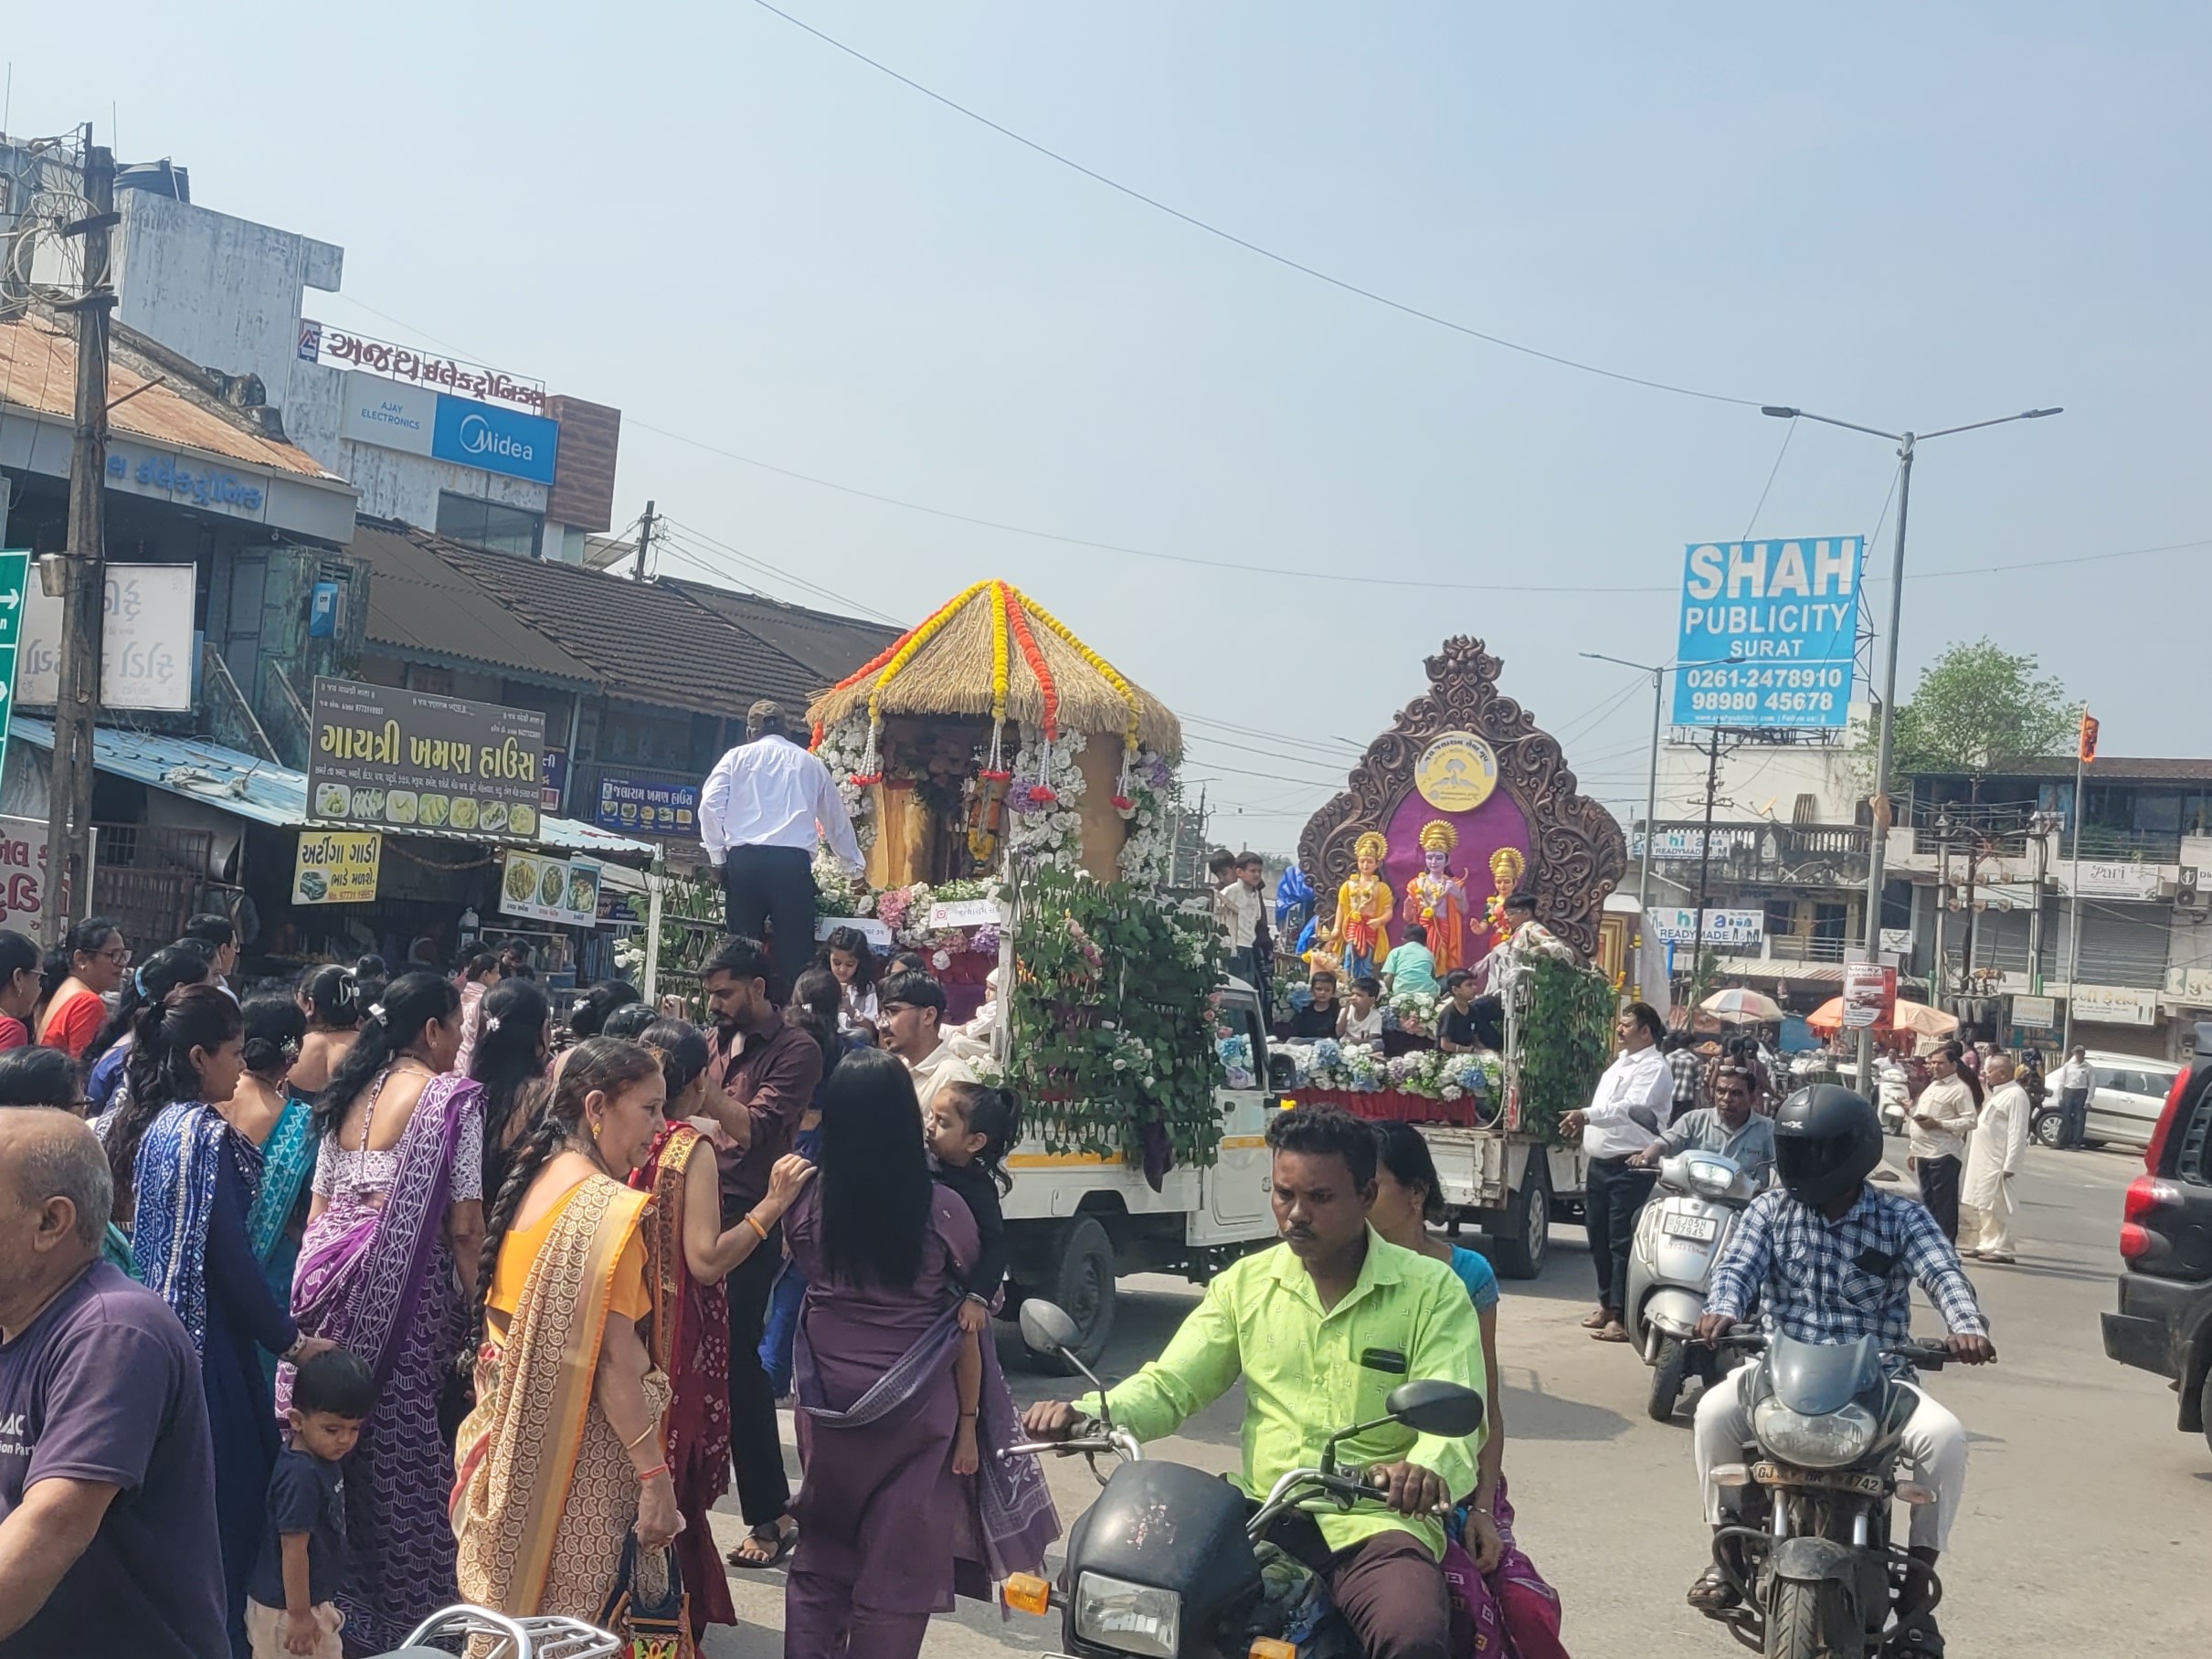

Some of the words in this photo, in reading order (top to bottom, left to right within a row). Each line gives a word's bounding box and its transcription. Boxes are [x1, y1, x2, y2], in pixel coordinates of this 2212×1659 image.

[327, 333, 419, 381] અજય
[381, 401, 403, 413] AJAY
[361, 408, 419, 430] ELECTRONICS
[464, 420, 533, 461] Midea
[1688, 539, 1856, 600] SHAH
[1686, 603, 1849, 634] PUBLICITY
[1730, 639, 1804, 657] SURAT
[1688, 668, 1842, 688] 0261-2478910
[1692, 692, 1757, 711] 98980
[1764, 691, 1833, 711] 45678
[321, 719, 400, 766] ગાયત્રી
[410, 735, 472, 775] ખમણ
[479, 736, 535, 781] હાઉસ
[613, 786, 644, 800] જલારામ
[647, 790, 669, 804] ખમણ
[672, 789, 693, 806] હાઉસ
[349, 837, 377, 863] ગાડી
[331, 868, 348, 886] ભાડે
[0, 1411, 26, 1436] AC
[1758, 1466, 1774, 1479] GJ
